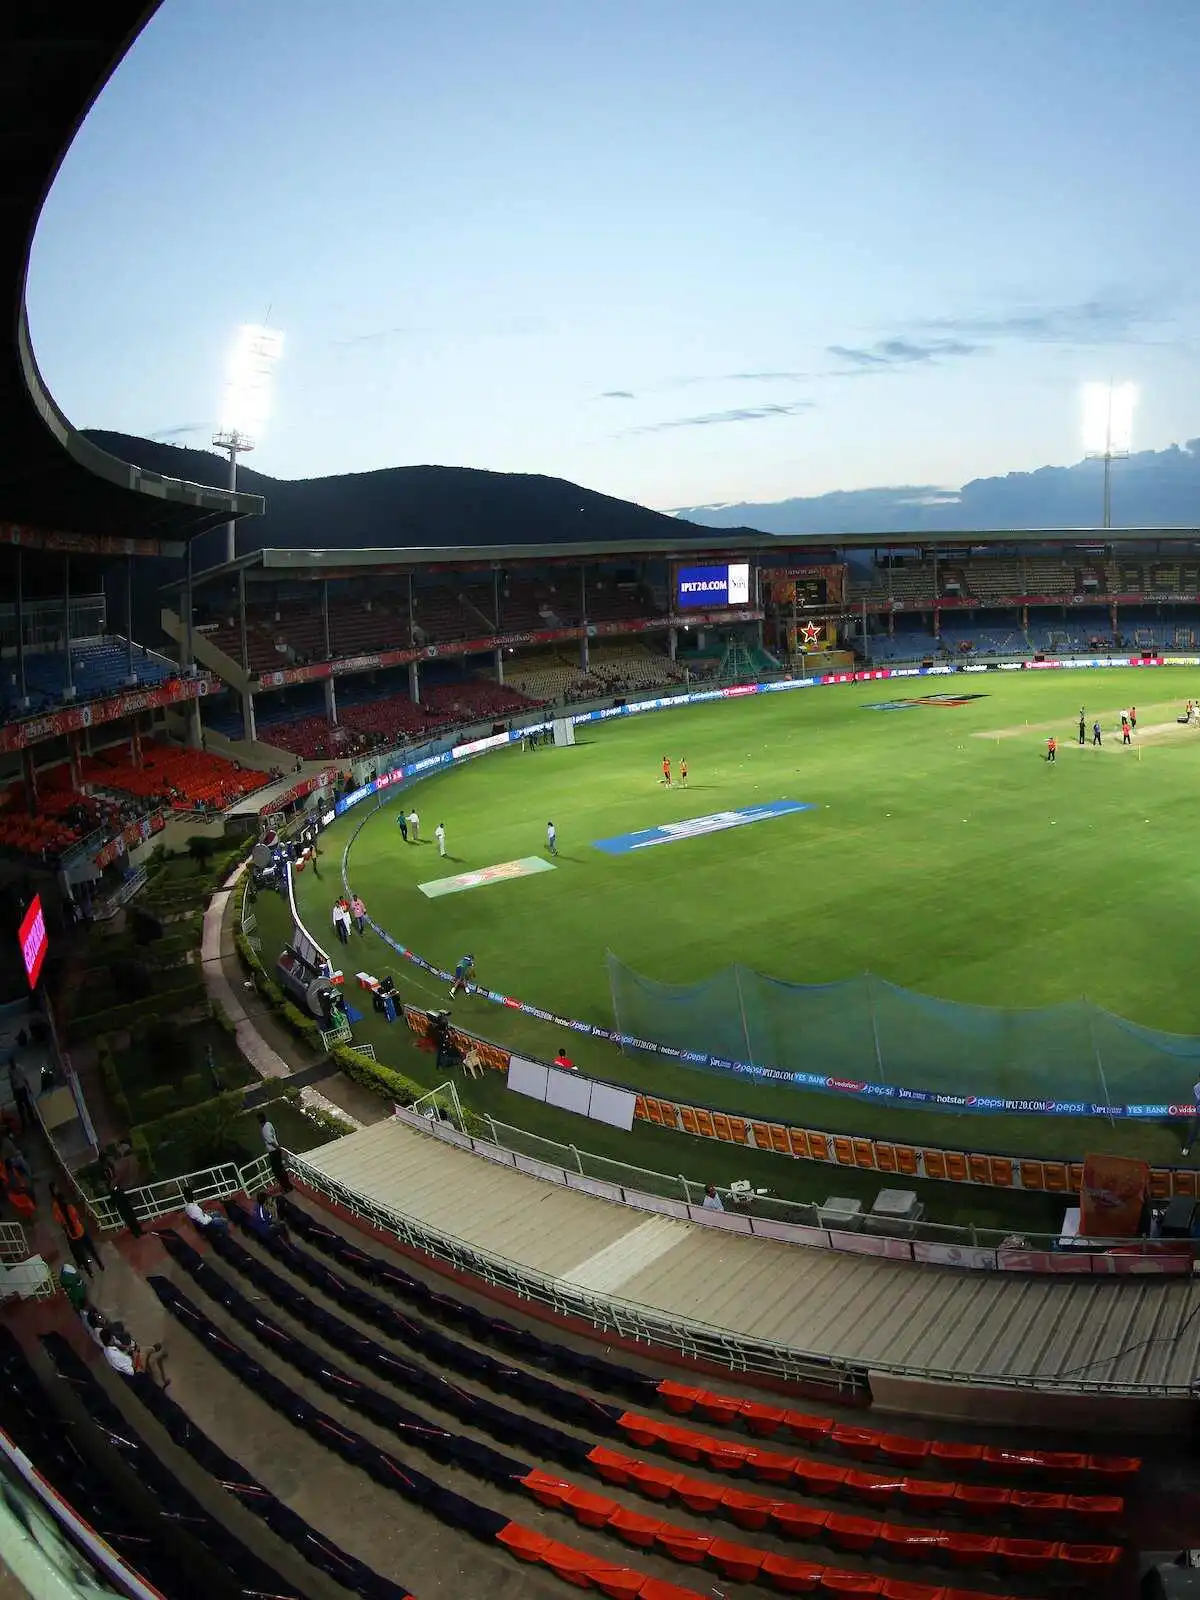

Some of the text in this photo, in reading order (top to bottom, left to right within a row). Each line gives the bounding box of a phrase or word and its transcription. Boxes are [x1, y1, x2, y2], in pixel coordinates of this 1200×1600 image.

[681, 580, 727, 592] IPLT20.COM
[575, 1022, 591, 1032] pepsi
[616, 1034, 634, 1044] pepsi
[634, 1038, 657, 1050] IPLT20.COM
[660, 1046, 680, 1056] hotstar
[686, 1053, 707, 1062] pepsi
[740, 1064, 763, 1074] pepsi
[763, 1068, 794, 1081] IPLT20.COM
[794, 1072, 825, 1087] YES BANK
[834, 1080, 858, 1089] vodafone
[868, 1086, 894, 1096] pepsi
[936, 1094, 965, 1105] hotstar
[977, 1098, 1005, 1108] pepsi
[1006, 1100, 1045, 1111] IPLT20.COM
[1056, 1103, 1084, 1112] pepsi
[1127, 1106, 1168, 1114] YES BANK
